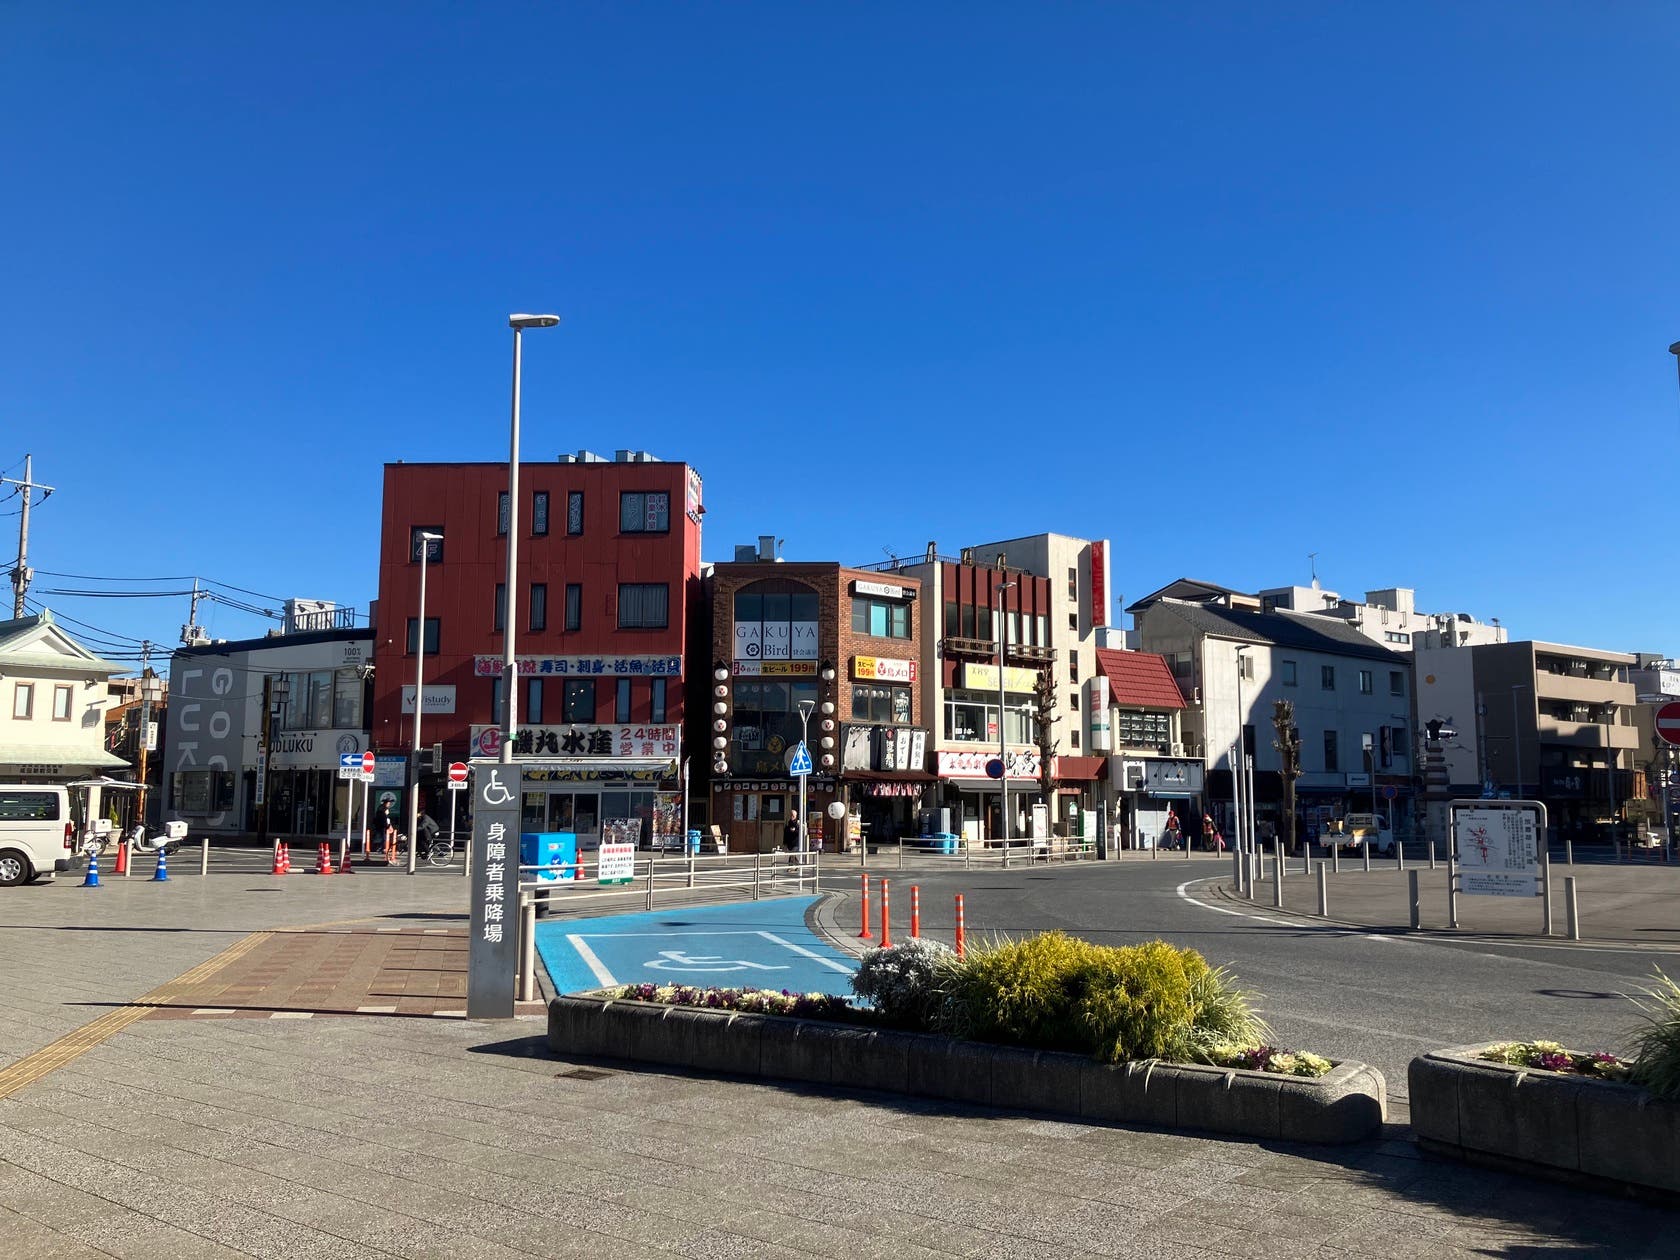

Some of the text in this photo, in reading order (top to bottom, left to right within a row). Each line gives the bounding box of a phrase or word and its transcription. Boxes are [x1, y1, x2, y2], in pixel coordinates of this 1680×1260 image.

[736, 626, 816, 638] GAKUYA
[764, 643, 789, 656] Bird
[477, 659, 537, 674] 海鮮焼
[762, 663, 816, 674] 生ビール 199円
[987, 677, 1014, 689] SEEN
[511, 727, 613, 755] 磯丸水産
[620, 727, 676, 742] 24時間
[257, 738, 313, 753] ODLUKKU
[619, 742, 676, 756] 営業中
[898, 736, 907, 765] おでん
[483, 822, 507, 943] 身障者乗降場
